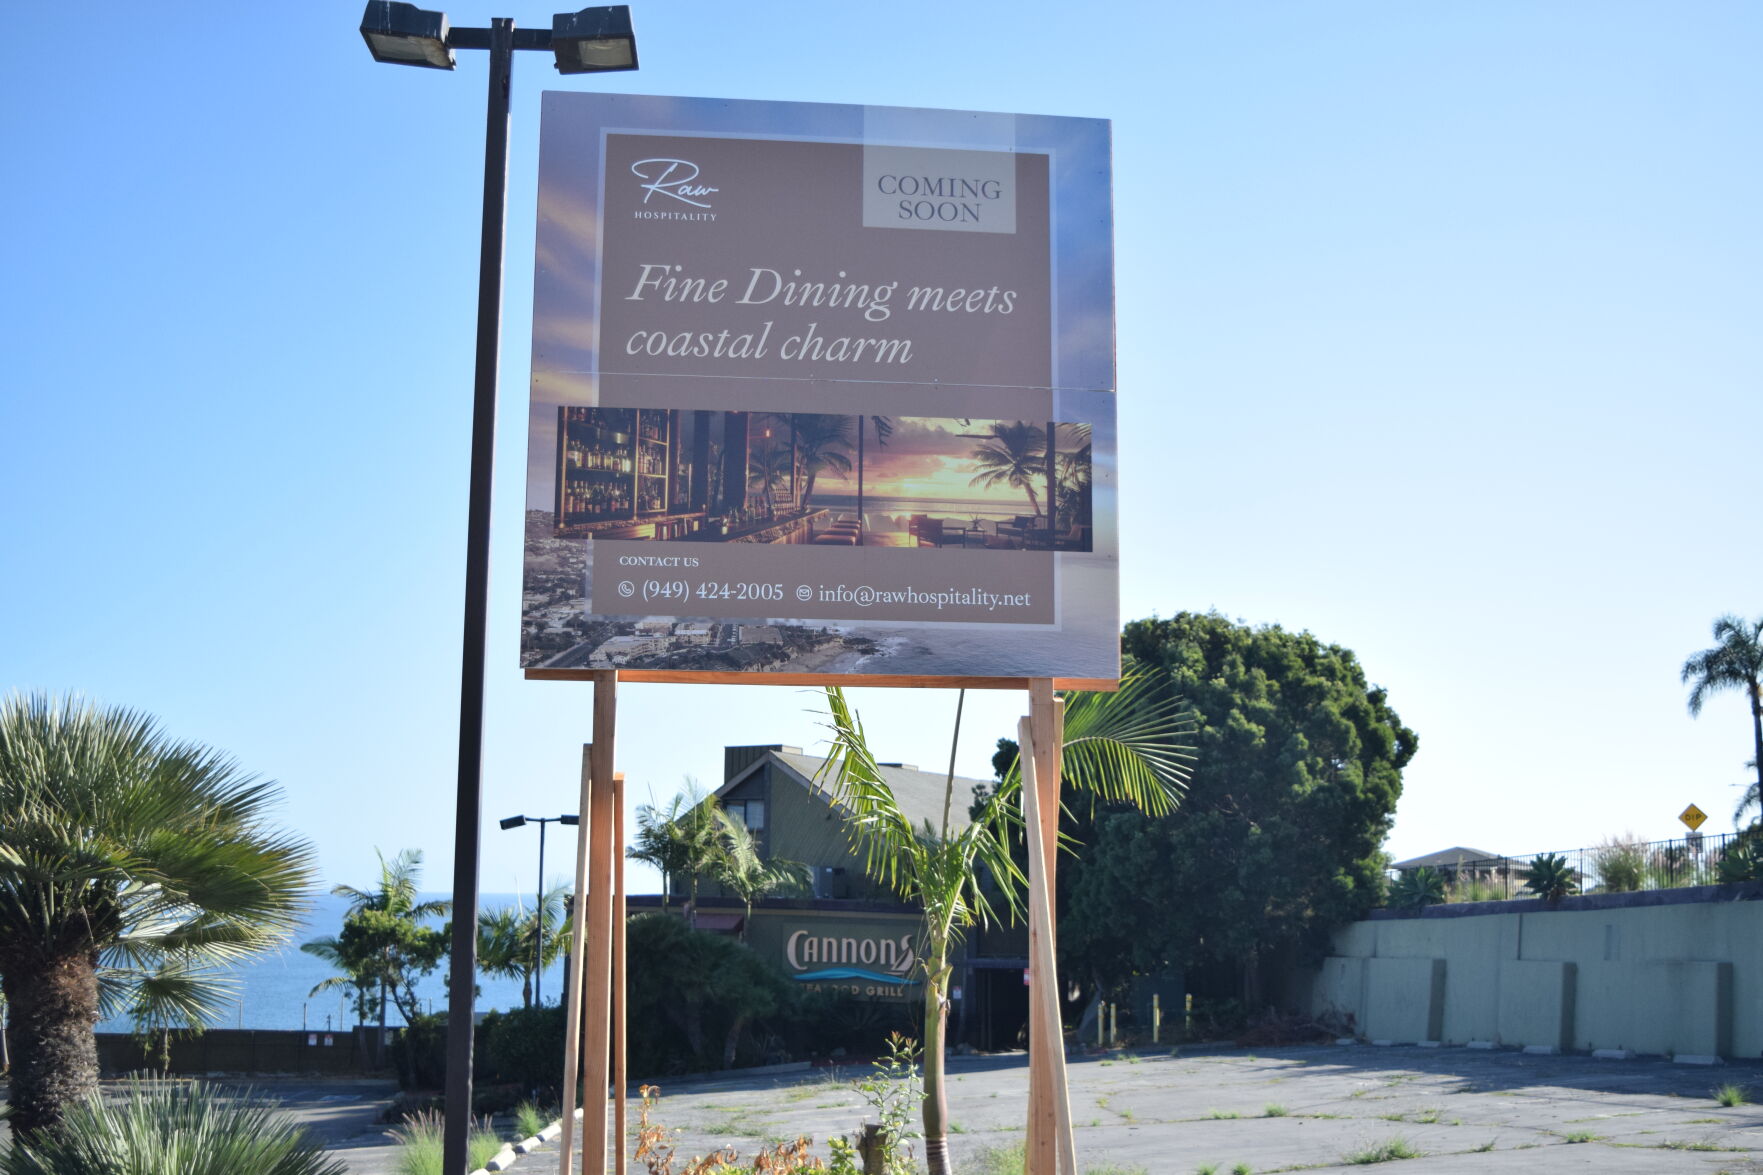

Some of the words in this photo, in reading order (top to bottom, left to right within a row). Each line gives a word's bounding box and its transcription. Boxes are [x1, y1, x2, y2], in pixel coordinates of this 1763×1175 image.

[631, 158, 719, 208] Raw
[877, 174, 1001, 200] COMING
[634, 211, 717, 222] HOSPITALITY
[898, 200, 981, 223] SOON
[626, 264, 728, 303] Fine
[735, 268, 898, 322] Dining
[907, 285, 1017, 315] meets
[626, 322, 774, 360] coastal
[780, 323, 913, 364] charm
[619, 555, 681, 568] CONTACT
[683, 557, 699, 568] US
[642, 580, 690, 604] (949)
[696, 582, 784, 601] 424-2005
[819, 584, 1031, 611] info@rawhospitality.net
[1685, 813, 1702, 821] DIP
[866, 985, 904, 997] GRILL
